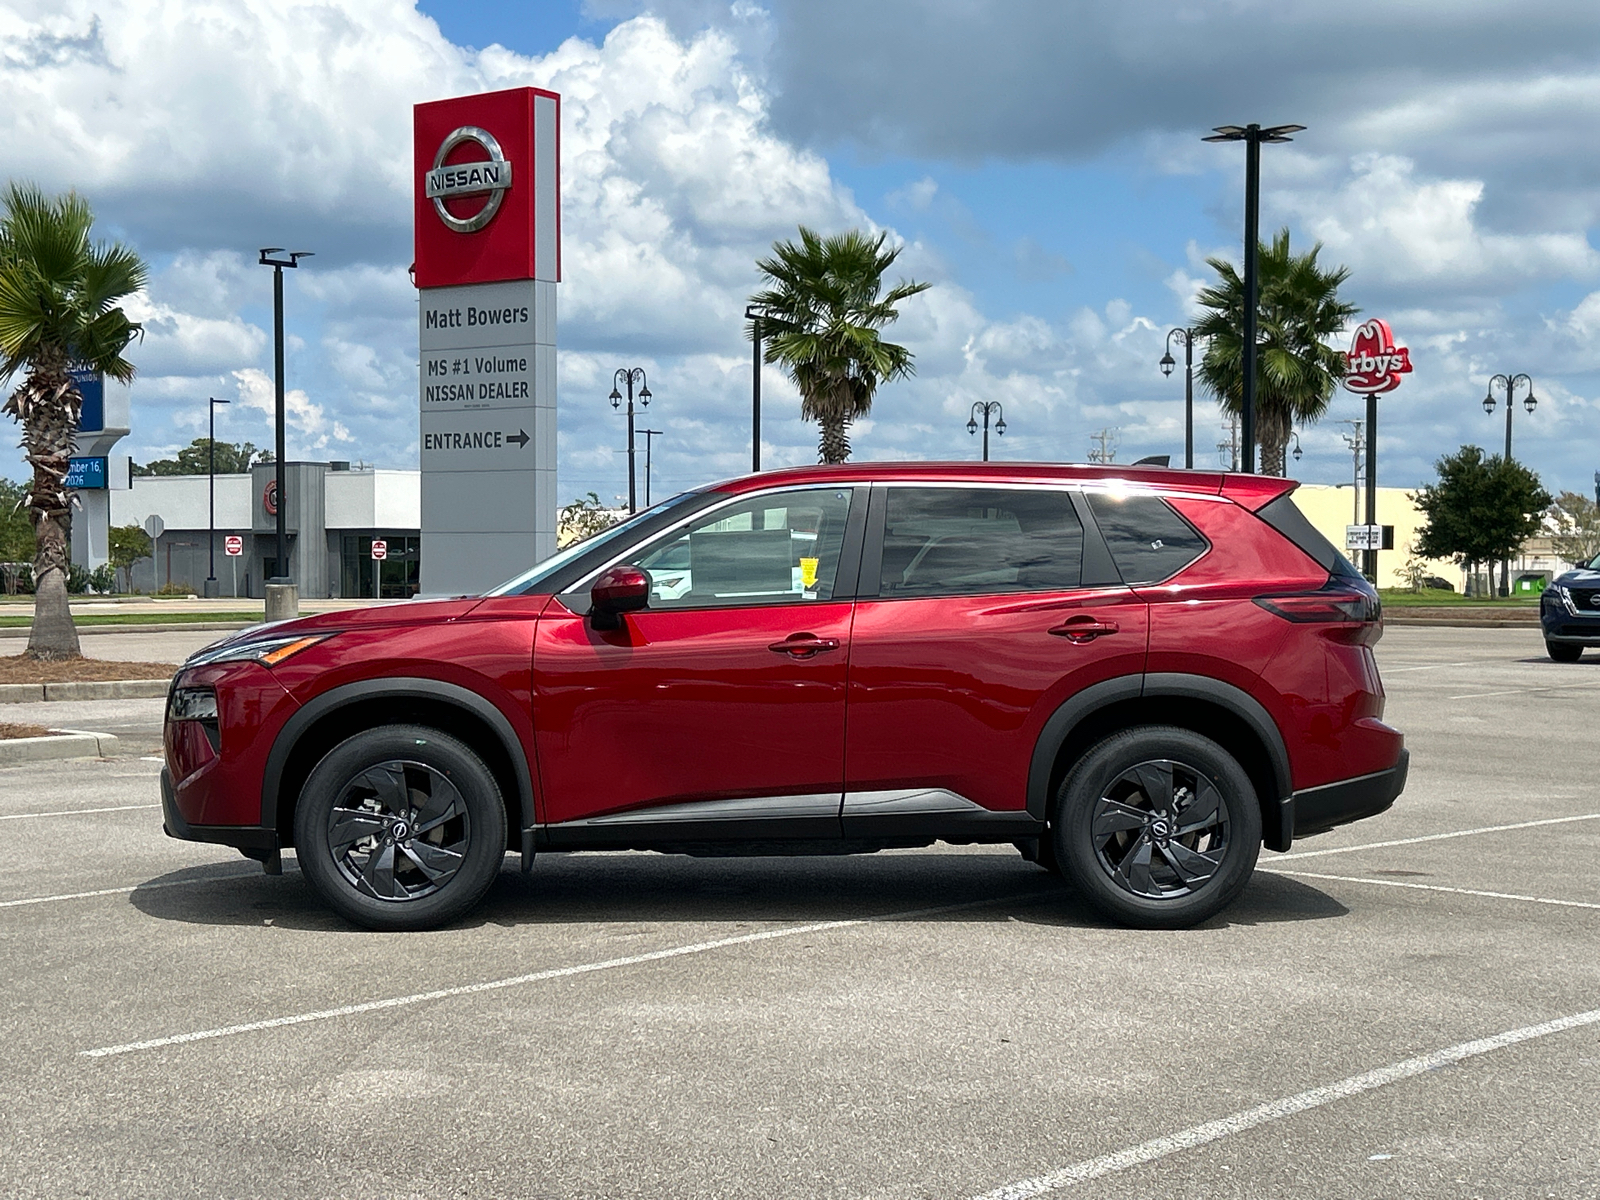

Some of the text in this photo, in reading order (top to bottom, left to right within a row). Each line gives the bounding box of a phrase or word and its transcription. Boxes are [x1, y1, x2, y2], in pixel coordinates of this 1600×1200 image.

[430, 167, 500, 191] NISSAN
[426, 307, 529, 329] Matt Bowers
[428, 356, 527, 377] MS #1 Volume
[426, 381, 530, 402] NISSAN DEALER
[424, 431, 502, 450] ENTRANCE
[90, 461, 102, 473] 16,
[65, 474, 84, 486] 2026
